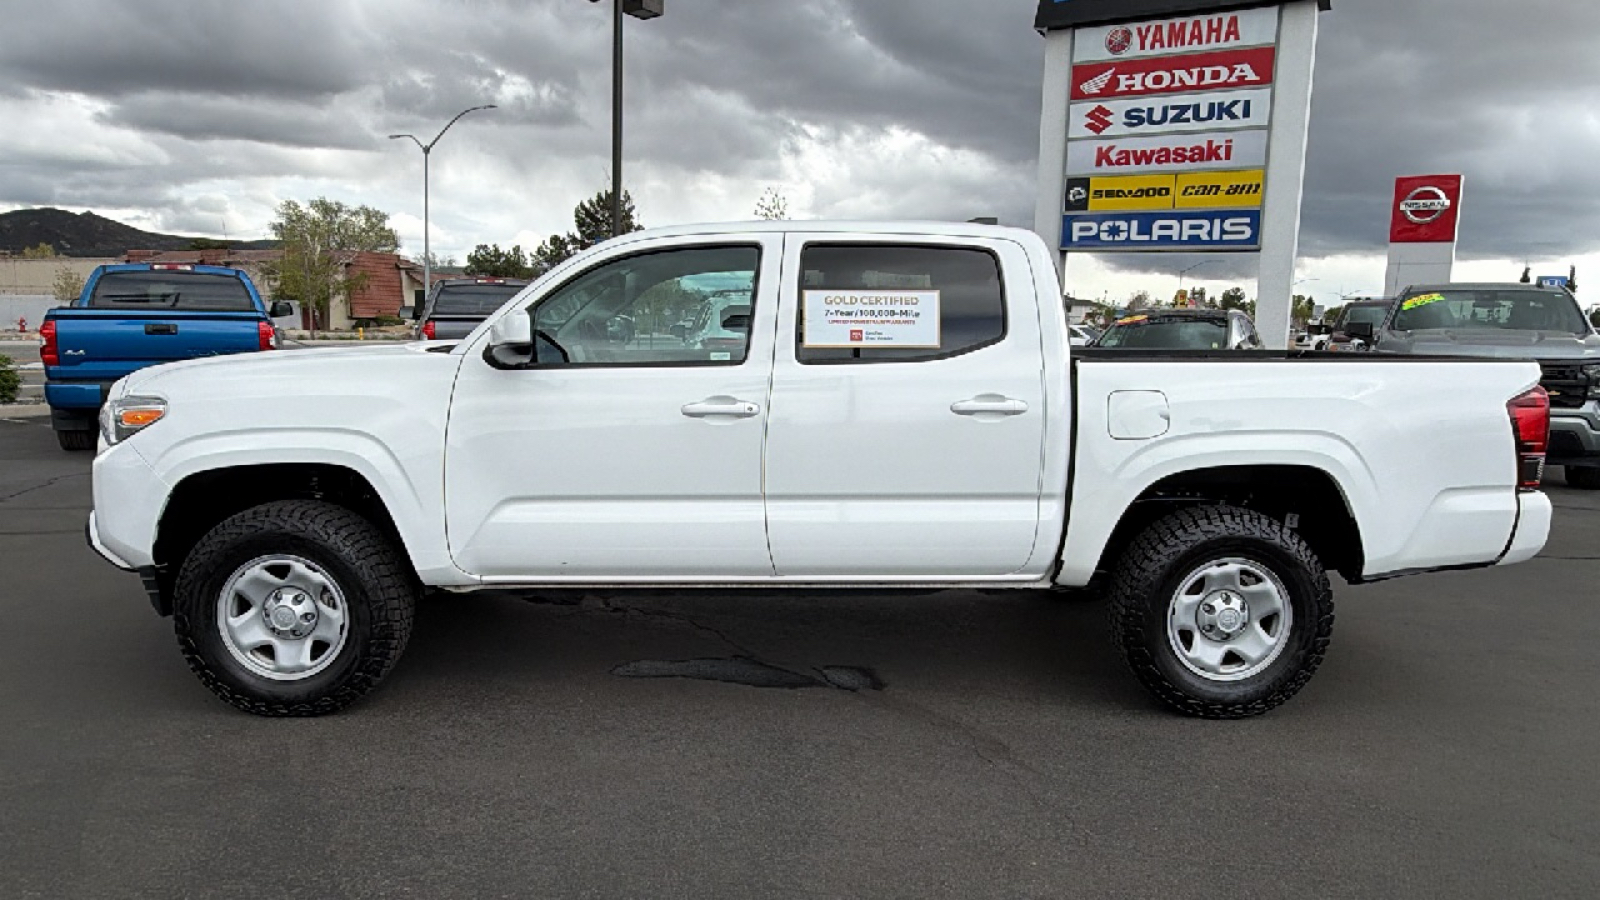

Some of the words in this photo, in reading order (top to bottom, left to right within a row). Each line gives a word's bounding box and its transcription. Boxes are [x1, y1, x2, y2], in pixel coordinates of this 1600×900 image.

[1136, 15, 1240, 51] YAMAHA
[1115, 62, 1260, 92] HONDA
[1123, 99, 1251, 127] SUZUKI
[1095, 139, 1233, 167] Kawasaki
[1181, 182, 1261, 197] can-am
[1404, 200, 1445, 209] NISSAN
[1071, 217, 1252, 242] POLARIS
[824, 295, 858, 306] GOLD
[859, 295, 920, 306] CERTIFIED
